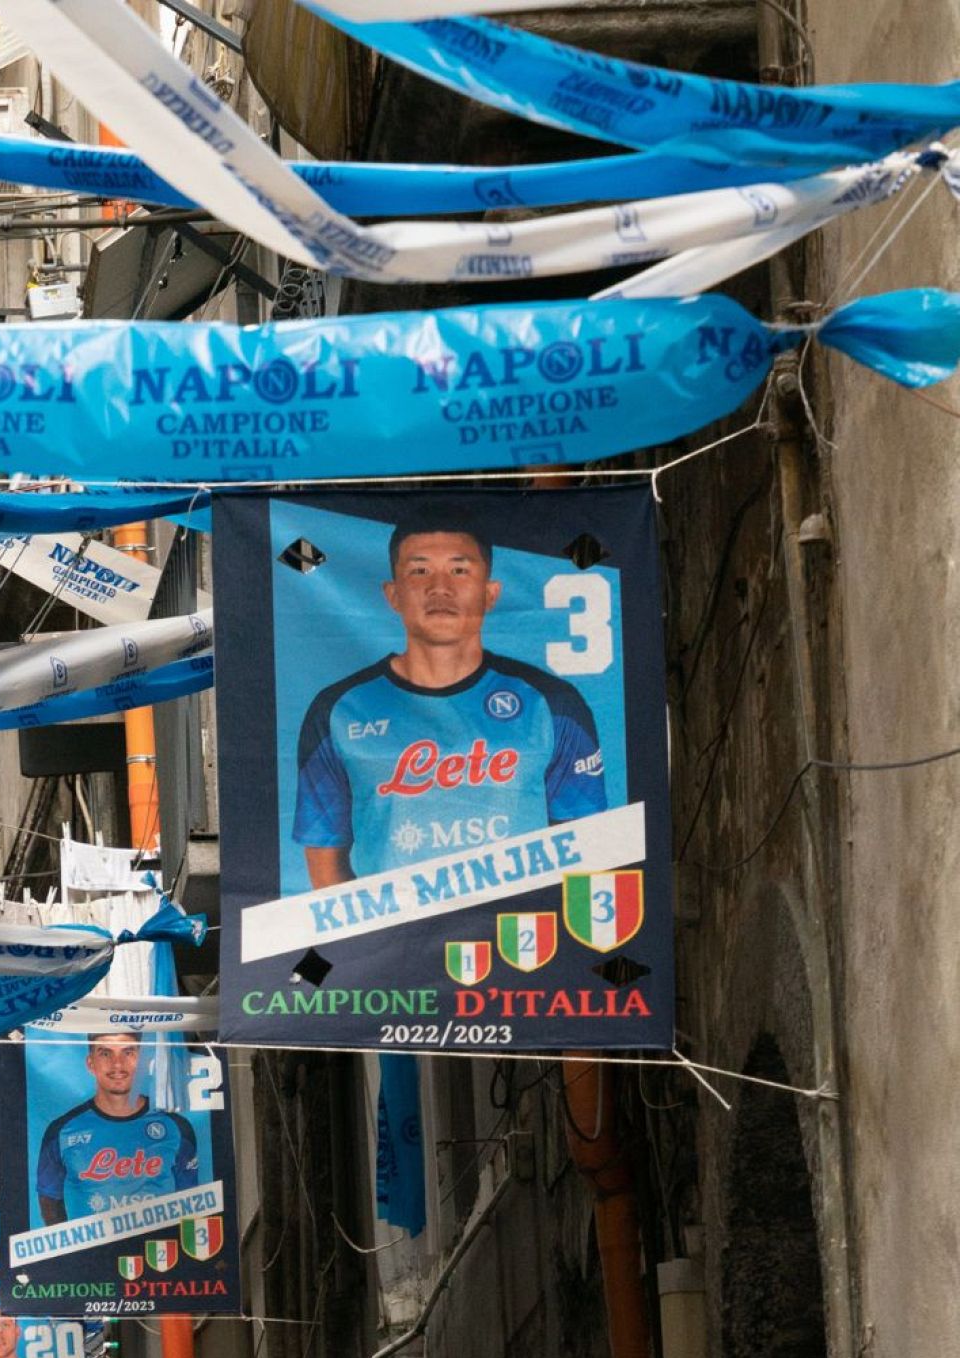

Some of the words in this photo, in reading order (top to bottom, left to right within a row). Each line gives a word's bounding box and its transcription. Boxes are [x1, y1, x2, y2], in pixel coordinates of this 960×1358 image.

[412, 332, 647, 394] NAPOLI
[131, 358, 360, 407] NAPOLI
[442, 386, 618, 426] CAMPIONE
[155, 410, 330, 437] CAMPIONE
[458, 416, 589, 445] D'ITALIA
[171, 437, 300, 460] D'ITALIA
[543, 572, 614, 676] 3
[347, 718, 391, 740] EA7
[376, 737, 521, 797] Lete
[431, 815, 511, 849] MSC
[308, 881, 401, 935] KIM
[411, 829, 583, 907] MINJAE
[591, 890, 616, 924] 3
[519, 929, 537, 952] 2
[464, 954, 473, 973] 1
[242, 988, 439, 1018] CAMPIONE
[455, 986, 652, 1018] D'ITALIA
[380, 1020, 514, 1046] 2022/2023
[79, 1147, 163, 1181] Lete
[14, 1221, 107, 1261] GIOVANNI
[112, 1189, 219, 1236] DILORENZO
[194, 1226, 209, 1247] 3
[157, 1249, 167, 1262] 2
[11, 1282, 116, 1298] CAMPIONE
[123, 1279, 228, 1296] D'ITALIA
[85, 1300, 156, 1314] 2022/2023
